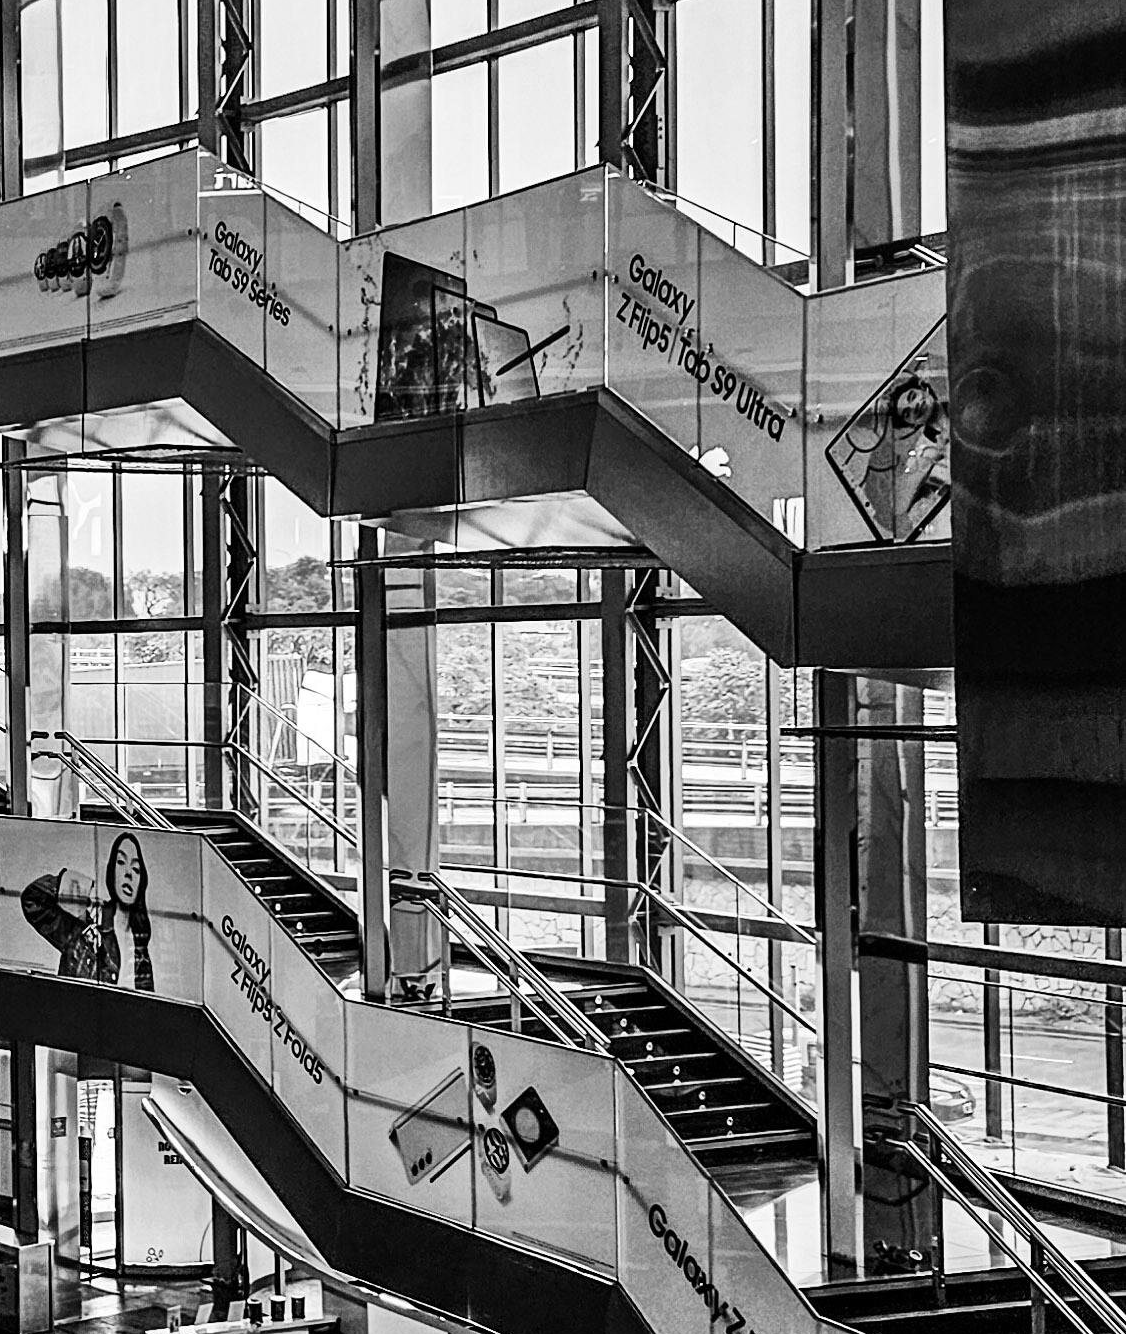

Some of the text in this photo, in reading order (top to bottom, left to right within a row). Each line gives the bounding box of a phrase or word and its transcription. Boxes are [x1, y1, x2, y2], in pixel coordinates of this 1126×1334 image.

[215, 221, 263, 274] Galaxy
[208, 249, 291, 327] Tab S9 Series
[628, 253, 695, 323] Galaxy
[615, 293, 785, 442] Z Flip5 Tab S9 Ultra
[221, 915, 270, 983] Galaxy
[231, 959, 323, 1085] Z Flip5 Z Fold5
[648, 1204, 727, 1323] Galaxy
